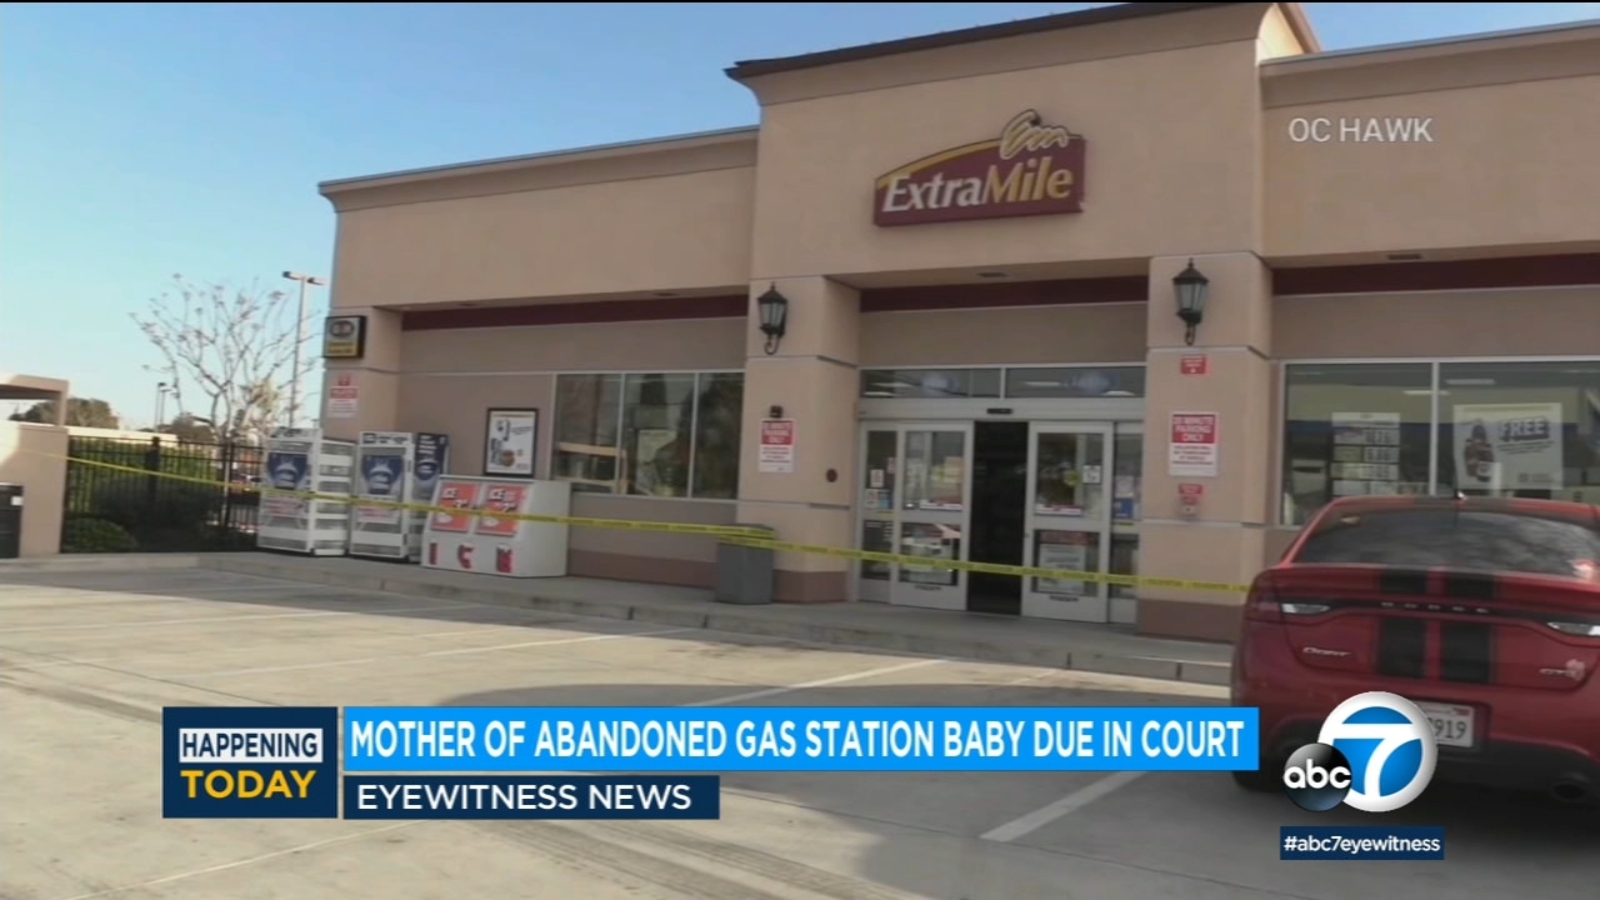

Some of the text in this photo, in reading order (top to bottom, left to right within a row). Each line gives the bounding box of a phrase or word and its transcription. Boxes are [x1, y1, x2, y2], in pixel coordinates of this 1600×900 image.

[881, 156, 1074, 212] ExtraMile
[1500, 417, 1549, 439] FREE
[1428, 717, 1467, 740] 919
